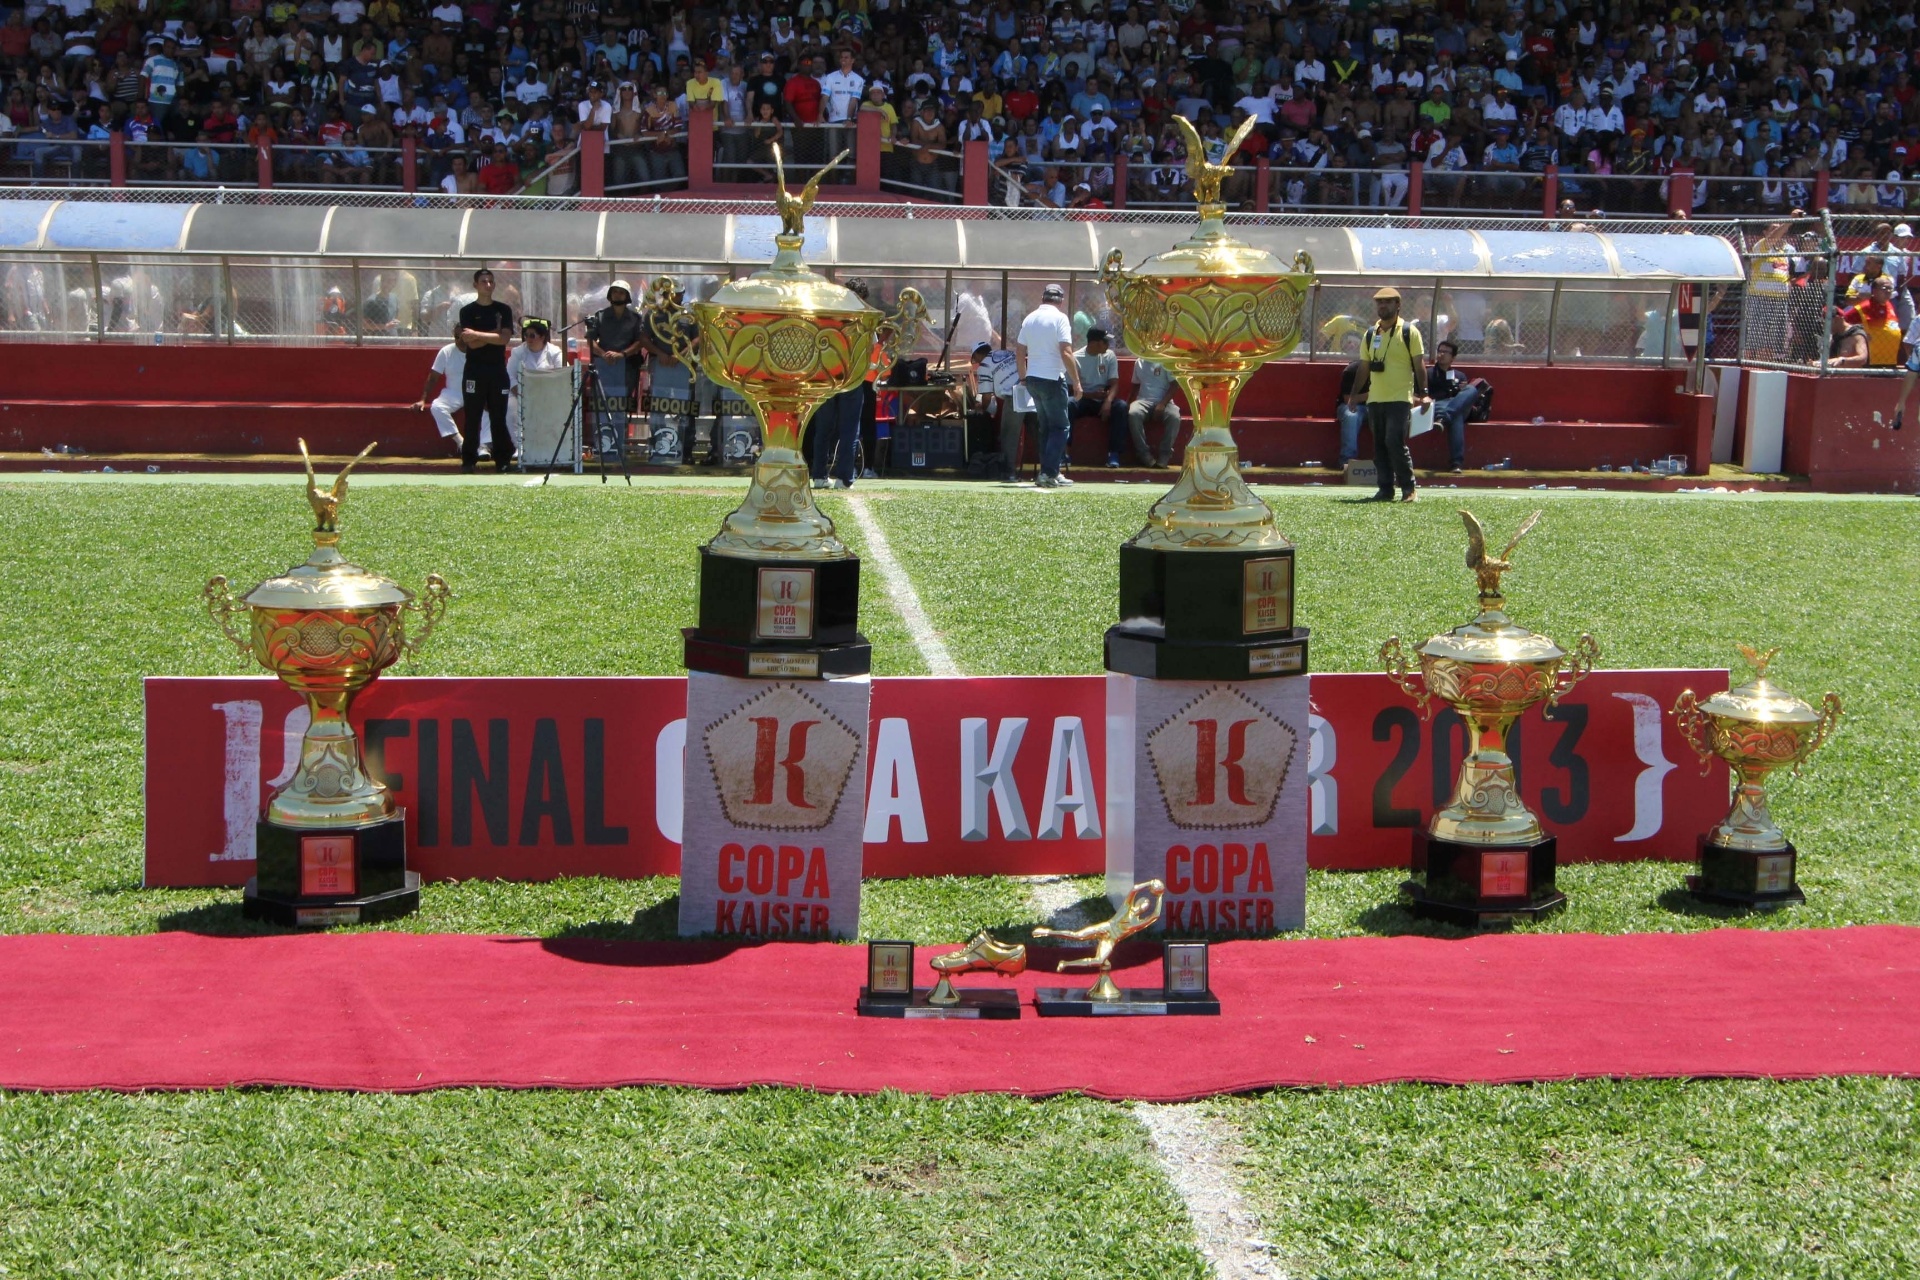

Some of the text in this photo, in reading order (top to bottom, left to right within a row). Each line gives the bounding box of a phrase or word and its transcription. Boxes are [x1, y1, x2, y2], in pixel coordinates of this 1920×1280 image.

[643, 397, 699, 415] CHOQUE
[714, 400, 753, 415] CHOQ
[774, 605, 796, 616] COPA
[774, 617, 796, 625] KAISER
[364, 717, 629, 847] FINAL
[717, 843, 830, 899] COPA
[1165, 843, 1274, 895] COPA
[715, 899, 830, 936] KAISER
[1165, 898, 1275, 931] KAISER
